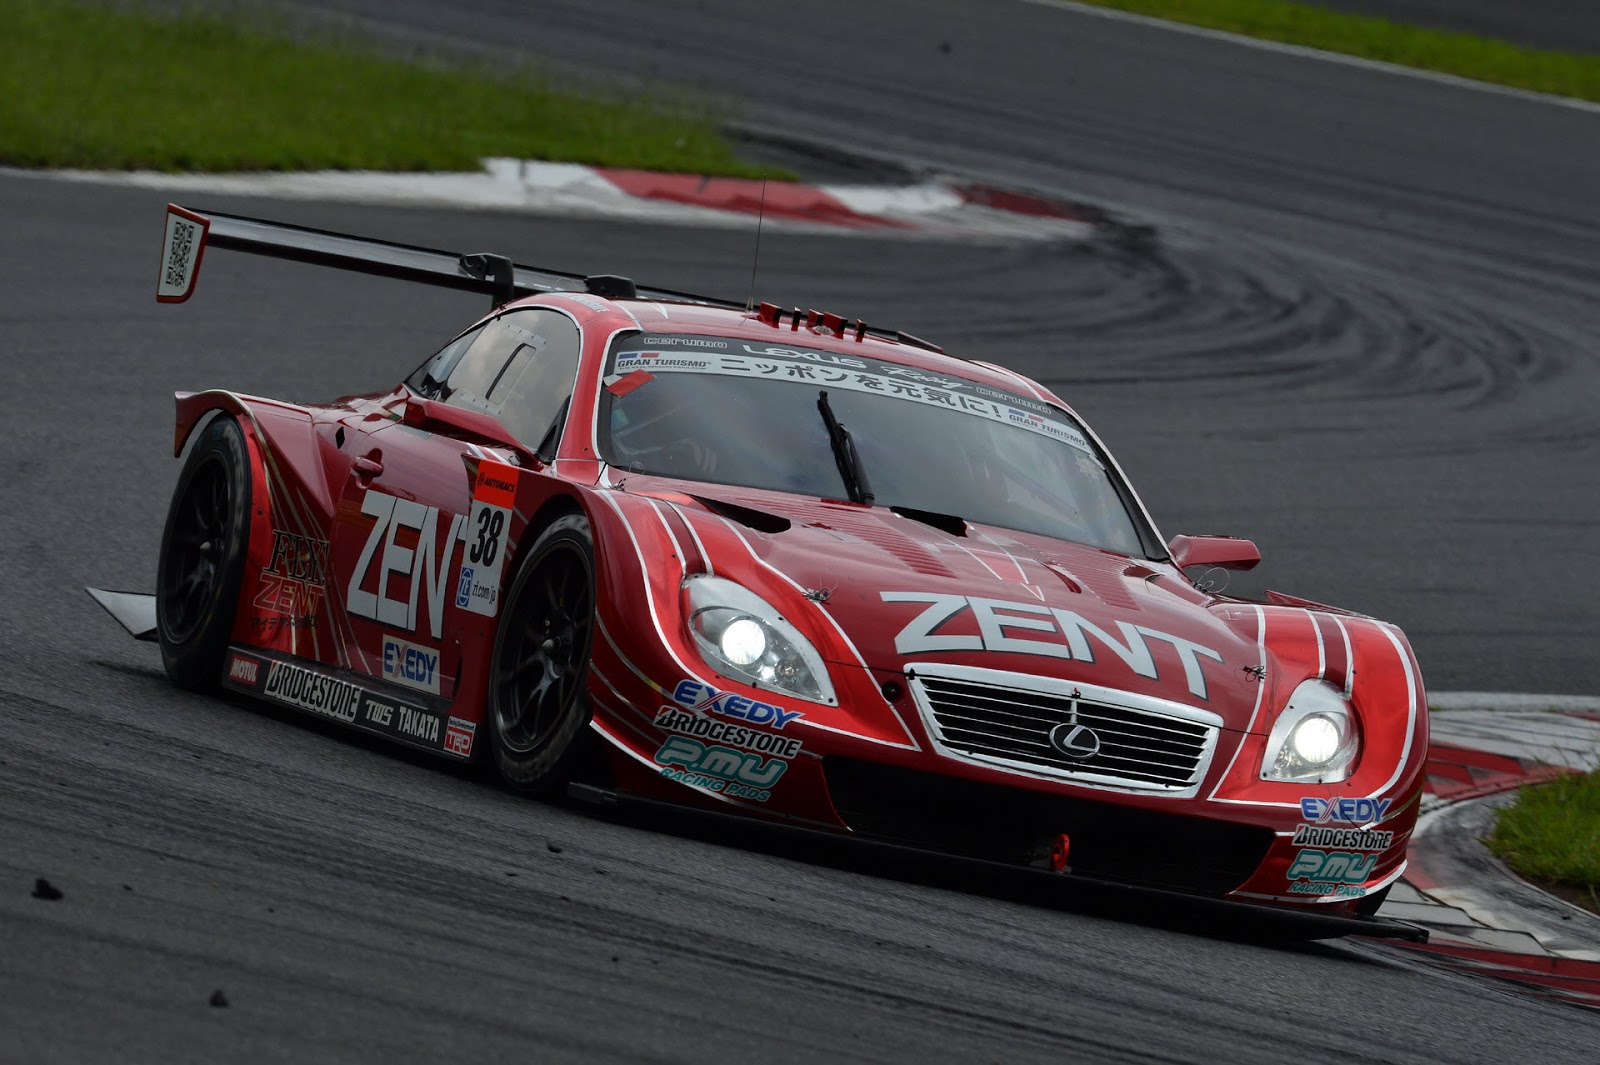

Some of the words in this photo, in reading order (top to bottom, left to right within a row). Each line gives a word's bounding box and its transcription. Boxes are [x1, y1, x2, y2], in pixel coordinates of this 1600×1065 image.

[617, 359, 651, 367] GRAN
[655, 359, 707, 368] TURISMO
[742, 344, 868, 369] LEXUS
[1009, 414, 1039, 428] GRAN
[1040, 424, 1086, 446] TURISMO
[483, 476, 515, 493] AUTOBACS
[469, 507, 505, 568] 38
[252, 572, 326, 619] ZENT
[879, 591, 1226, 701] ZENT
[230, 658, 257, 684] MOTUL
[383, 641, 438, 686] EXEDY
[265, 660, 361, 720] BRIDGESTONE
[674, 680, 804, 729] EXEDY
[366, 700, 394, 726] TWS
[398, 706, 441, 742] TAKATA
[447, 730, 471, 753] TRD
[654, 706, 802, 758] BRIDGESTONE
[661, 768, 726, 791] RACING
[725, 784, 772, 802] PADS
[1301, 798, 1393, 822] EXEDY
[1293, 824, 1393, 850] BRIDGESTONE
[1288, 882, 1334, 896] RACING
[1335, 884, 1367, 898] PADS
